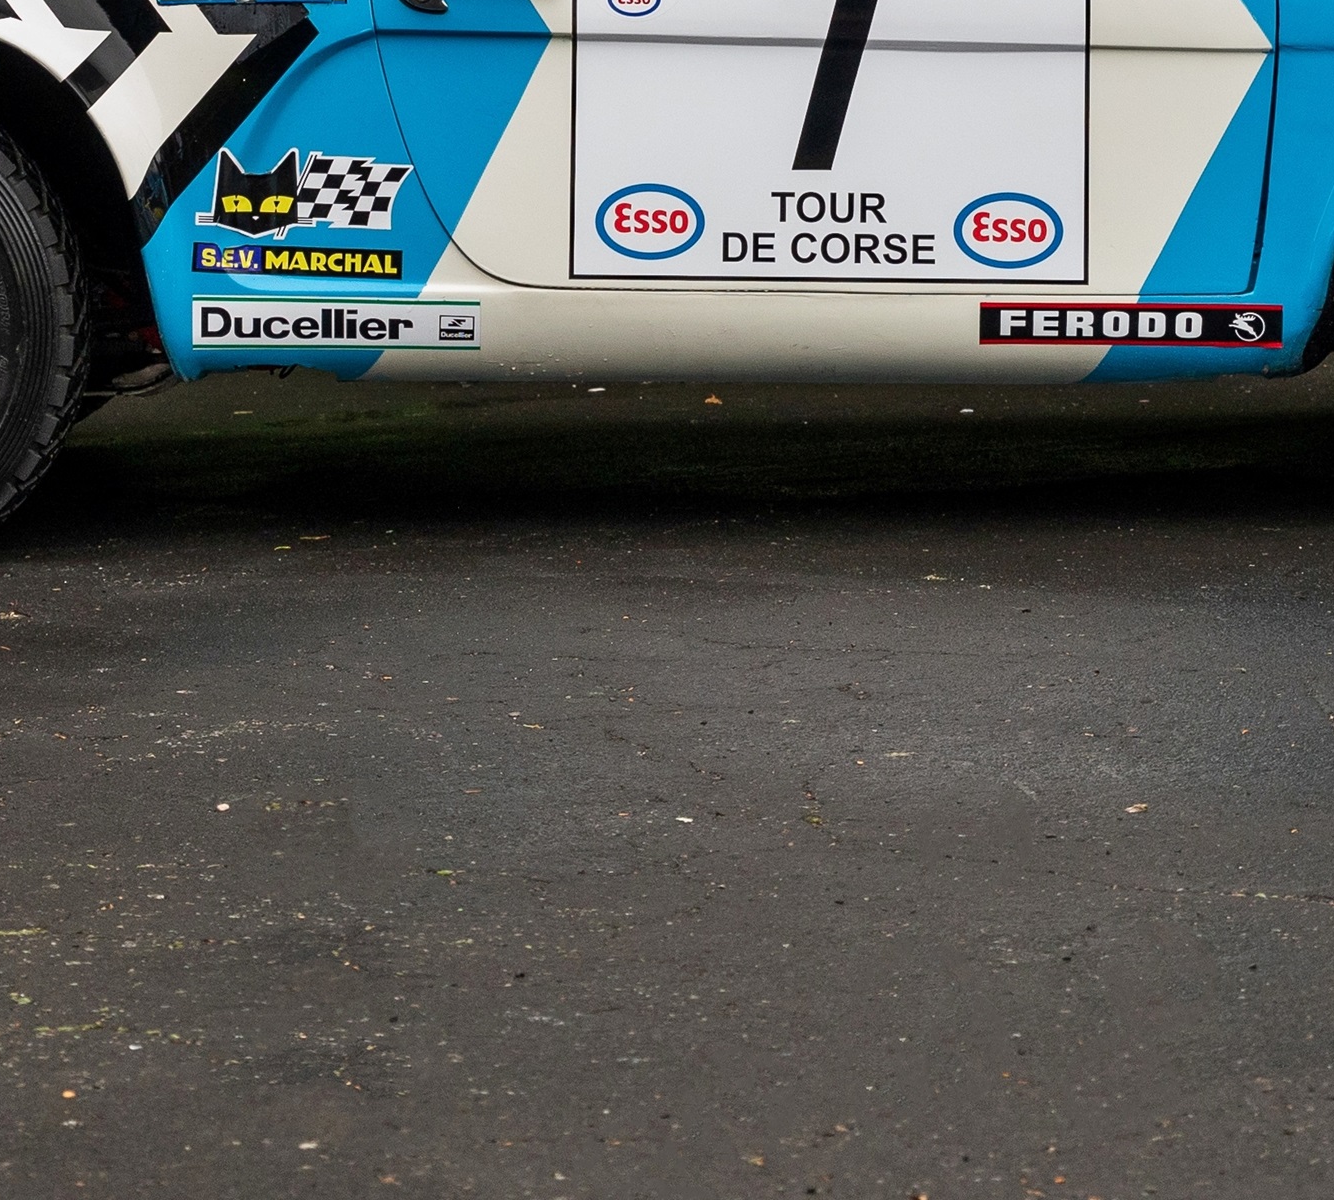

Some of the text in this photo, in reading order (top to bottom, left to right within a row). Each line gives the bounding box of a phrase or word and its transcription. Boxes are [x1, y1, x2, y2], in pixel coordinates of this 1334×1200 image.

[613, 202, 689, 235] Esso
[771, 191, 887, 224] TOUR
[971, 211, 1048, 243] Esso
[200, 248, 398, 275] S.E.V. MARCHAL
[721, 232, 936, 266] DE CORSE
[200, 307, 414, 341] Ducellier
[999, 309, 1204, 339] FERODO
